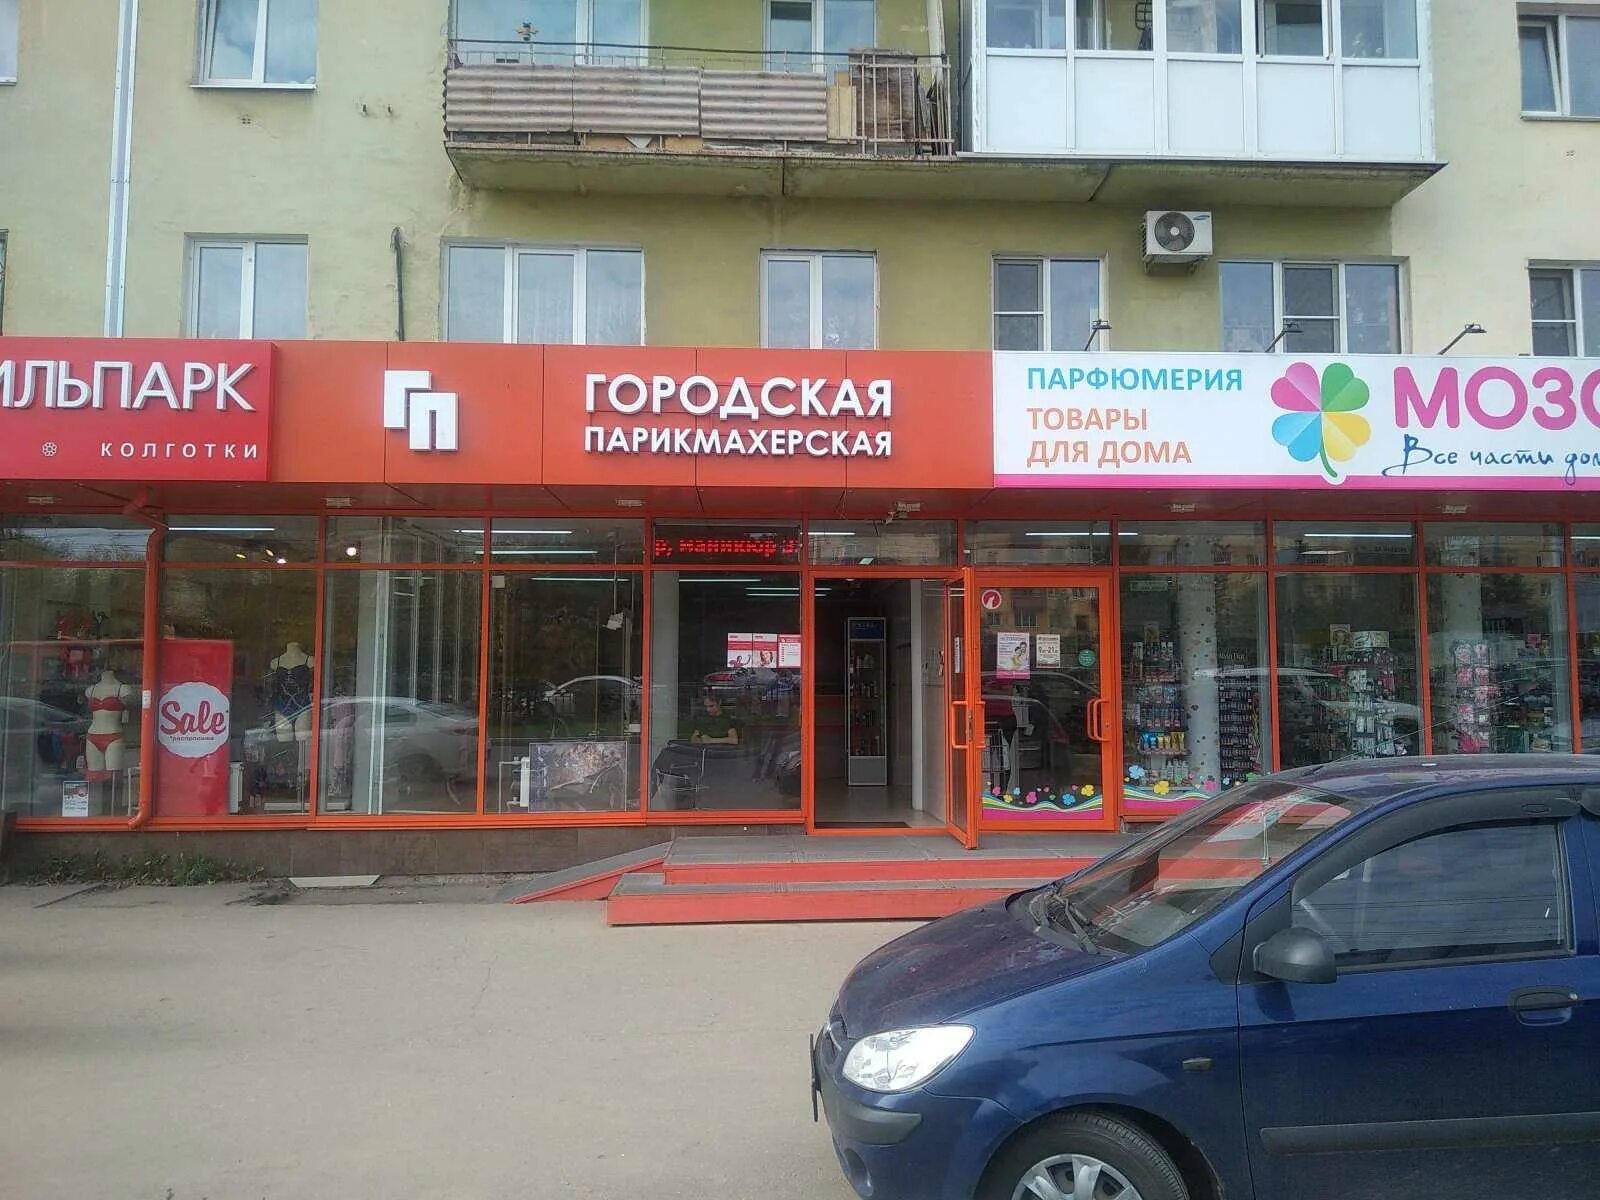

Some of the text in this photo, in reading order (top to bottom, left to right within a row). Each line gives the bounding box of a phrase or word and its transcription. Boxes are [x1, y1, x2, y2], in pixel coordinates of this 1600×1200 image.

[1027, 367, 1242, 391] ПАРФЮМЕРИЯ
[585, 373, 893, 420] ГОРОДСКАЯ
[1026, 407, 1148, 431] ТОВАРЫ
[101, 441, 258, 459] КОЛГОТКИ
[584, 426, 893, 457] ПАРИКМАХЕРСКАЯ
[1026, 440, 1193, 468] ДЛЯ ДОМА
[1381, 433, 1459, 477] Все
[1469, 449, 1554, 466] части
[160, 700, 226, 735] Sale
